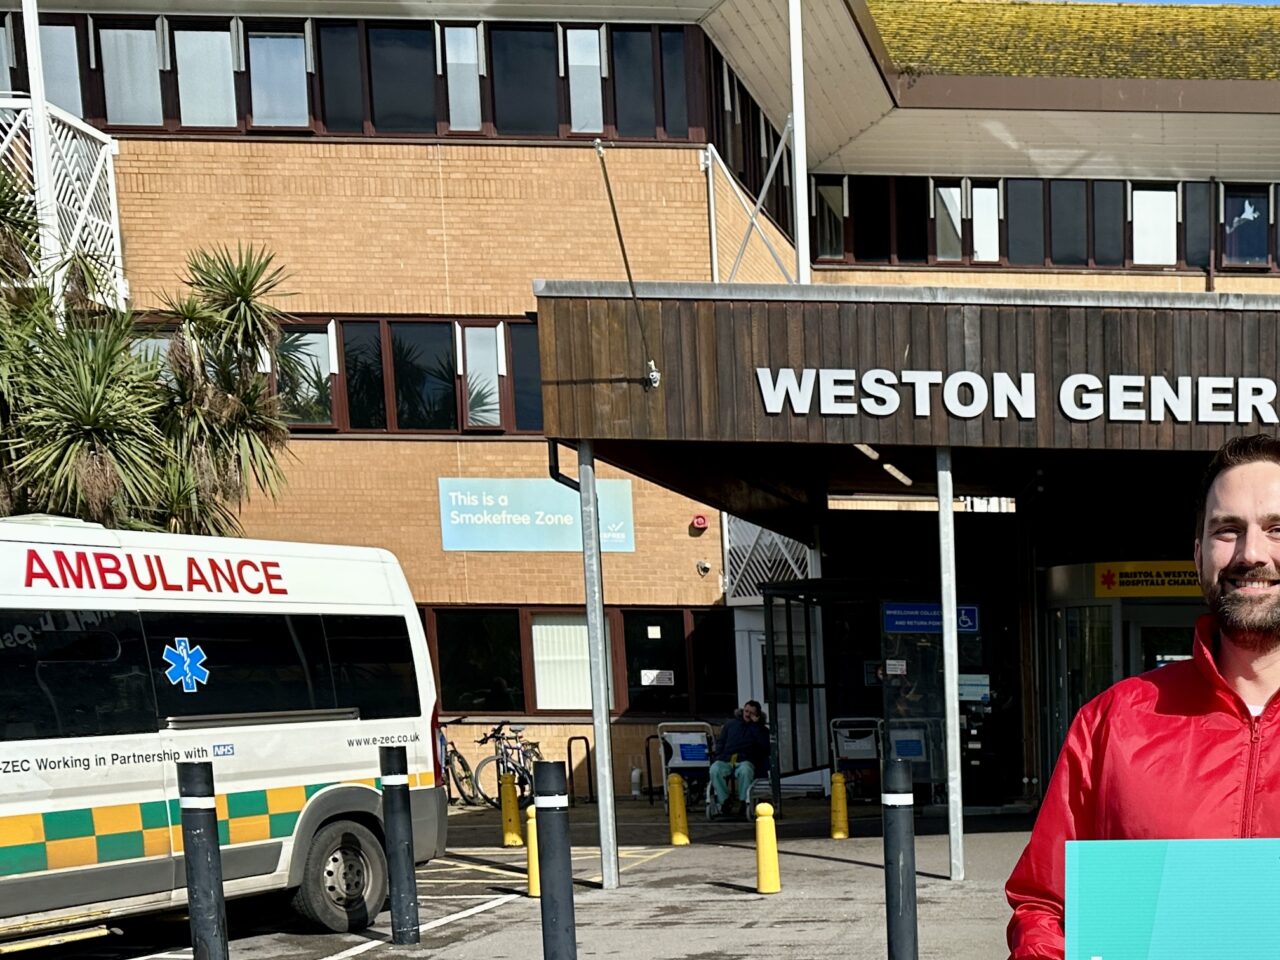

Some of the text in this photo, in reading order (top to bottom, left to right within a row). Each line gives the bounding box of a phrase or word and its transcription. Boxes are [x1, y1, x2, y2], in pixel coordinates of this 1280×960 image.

[755, 367, 1036, 419] WESTON
[449, 491, 509, 506] This is a
[450, 510, 574, 525] Smokefree Zone
[24, 549, 289, 595] AMBULANCE
[1119, 571, 1154, 579] BRISTOL
[1119, 579, 1201, 587] HOSPITALS CHARI
[347, 732, 420, 747] www.e-zec.co.uk
[36, 756, 90, 771] Working
[95, 754, 107, 766] in
[111, 748, 181, 766] Partnership
[184, 746, 208, 759] with
[214, 745, 234, 756] NHS
